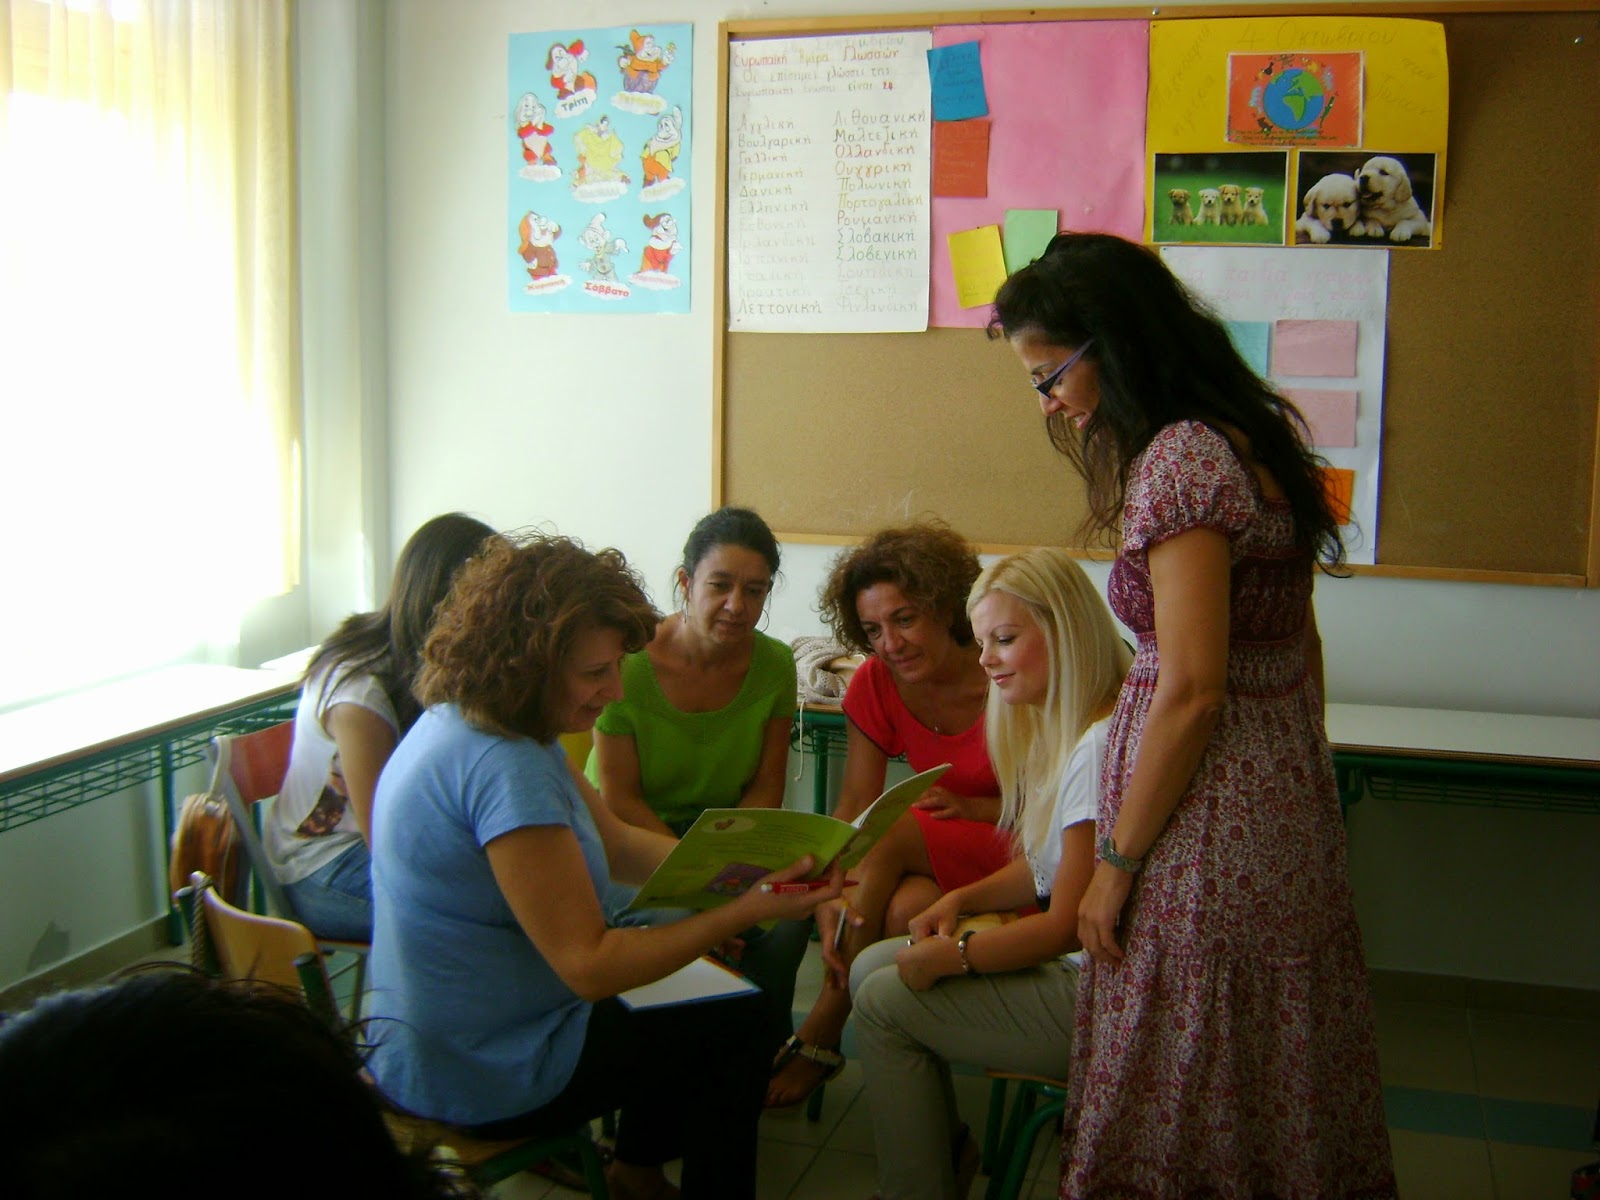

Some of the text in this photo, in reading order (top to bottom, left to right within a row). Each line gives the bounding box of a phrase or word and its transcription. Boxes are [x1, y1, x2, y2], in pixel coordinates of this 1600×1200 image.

[883, 81, 895, 91] 24
[561, 97, 588, 111] Τρίτη
[737, 112, 795, 135] Αγγλική
[832, 110, 926, 127] Λιθουανική
[738, 135, 811, 150] Βουλγαρική
[833, 126, 918, 143] Μαλτεζική
[738, 151, 787, 165] Γαλλική
[835, 143, 915, 159] Ολλανδική
[835, 160, 912, 178] Ουγγρική
[739, 185, 792, 198] Δανική
[837, 178, 912, 193] Πολωνική
[739, 201, 809, 214] Ελληνική
[838, 193, 925, 212] Πορτογαλική
[837, 209, 917, 228] Ρουμανική
[837, 227, 915, 244] Σλοβακική
[836, 244, 917, 262] Σλοβενική
[584, 282, 629, 298] Σάββατο
[737, 300, 823, 315] Λεττονική
